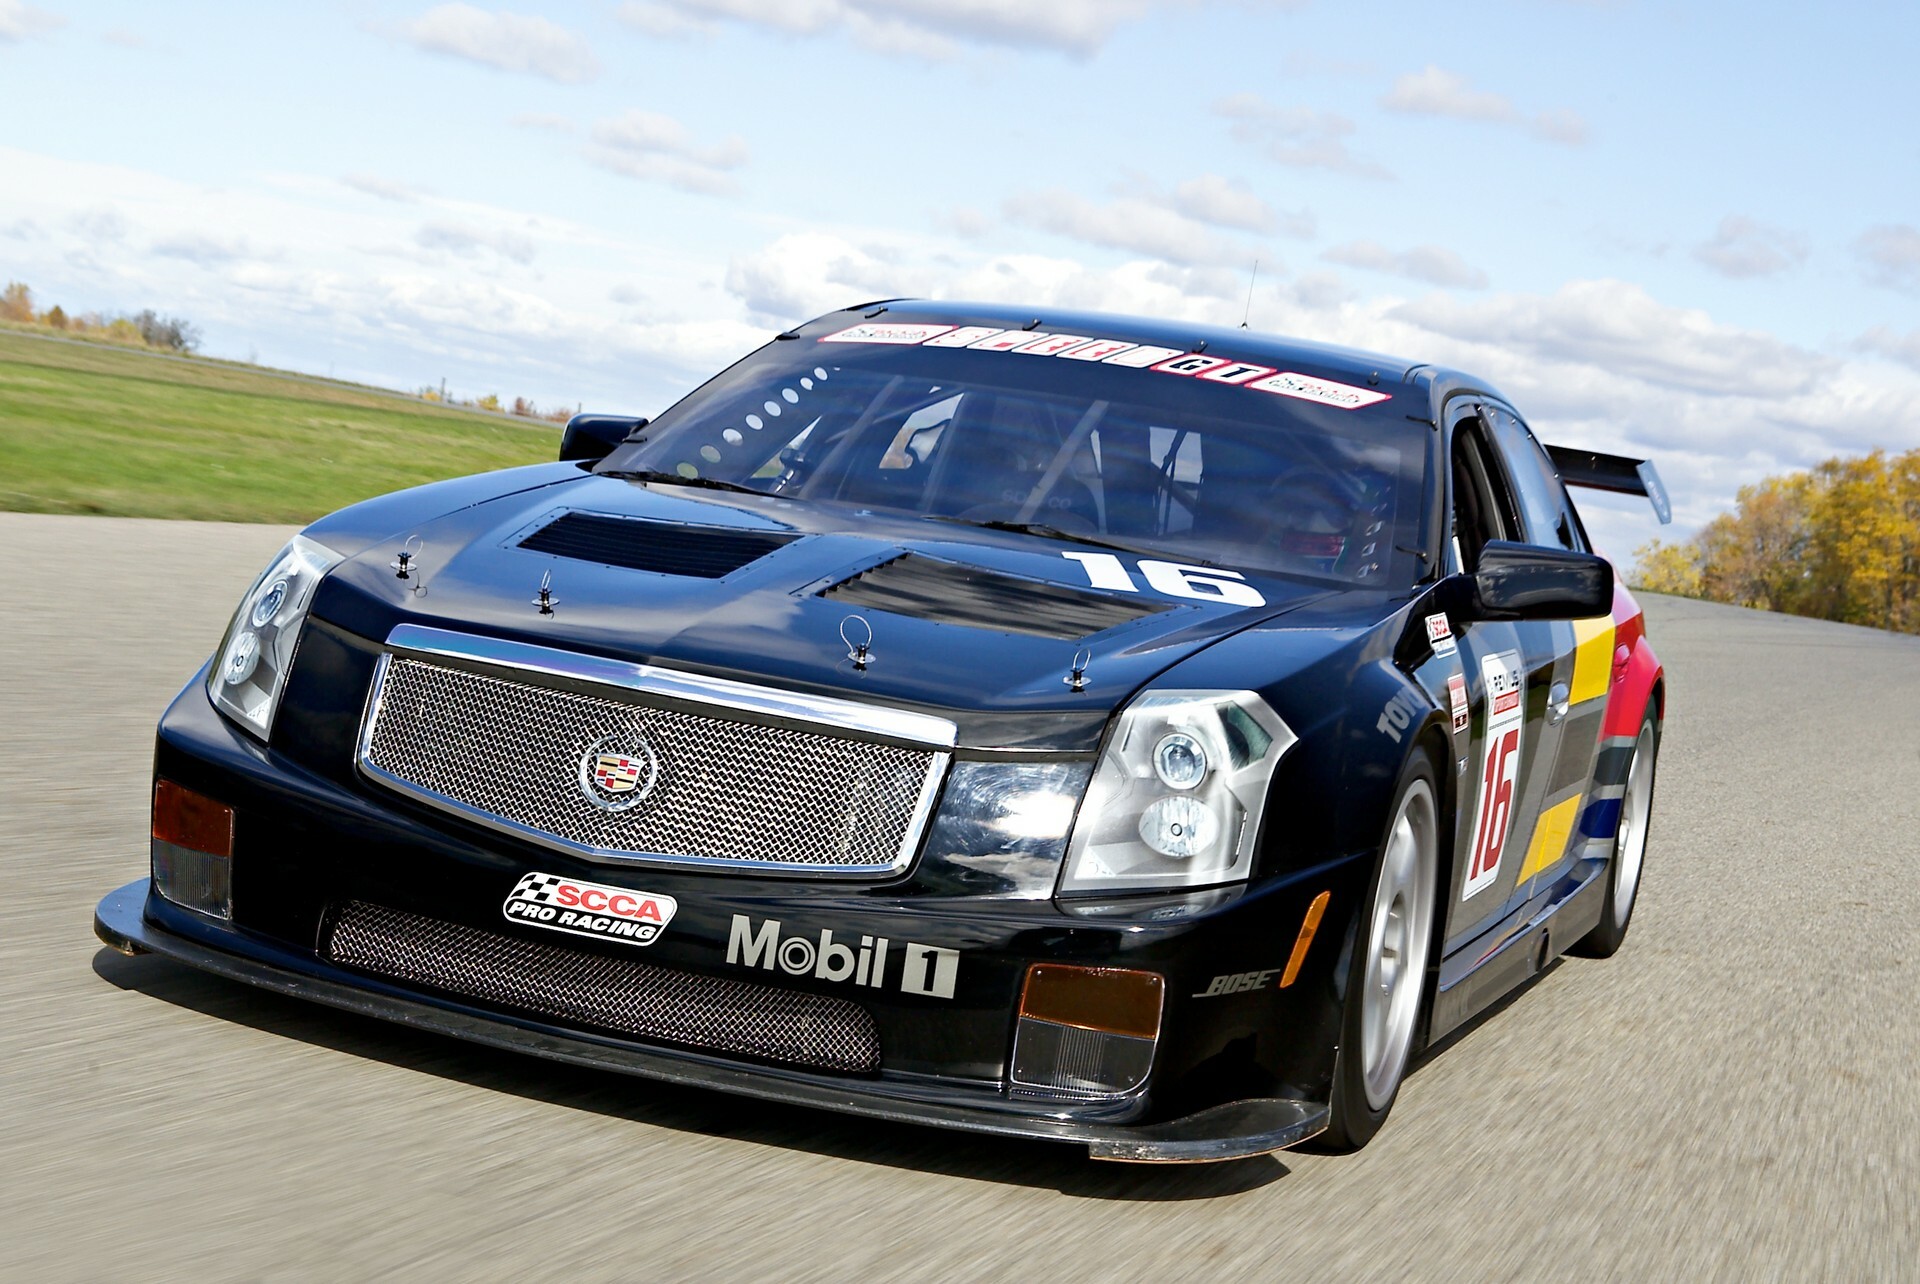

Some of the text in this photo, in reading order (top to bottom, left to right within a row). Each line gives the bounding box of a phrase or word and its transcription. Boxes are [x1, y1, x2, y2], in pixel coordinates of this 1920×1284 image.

[1169, 358, 1260, 378] GT
[1061, 551, 1267, 608] 16
[1470, 729, 1519, 881] 16
[508, 901, 657, 940] PRO RACING
[556, 884, 662, 922] SCCA
[726, 914, 889, 988] Mobil
[1192, 968, 1281, 998] BOSE
